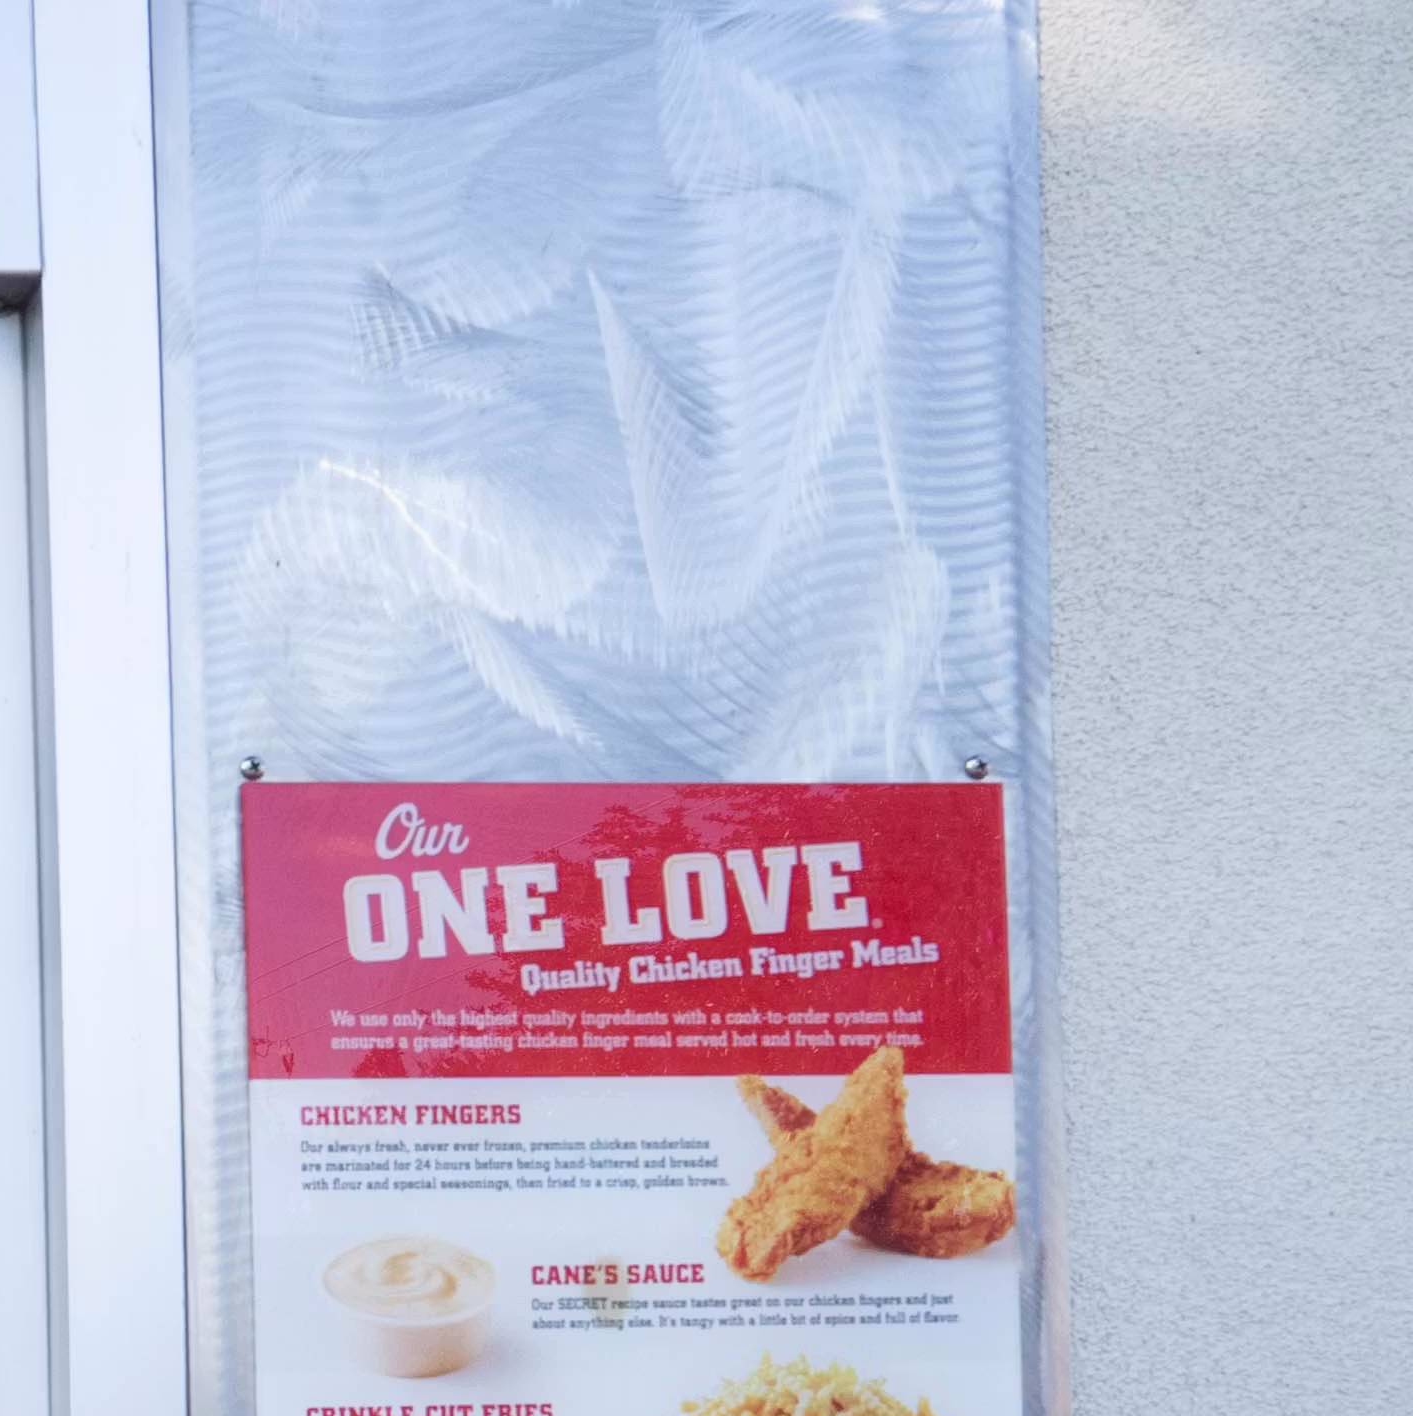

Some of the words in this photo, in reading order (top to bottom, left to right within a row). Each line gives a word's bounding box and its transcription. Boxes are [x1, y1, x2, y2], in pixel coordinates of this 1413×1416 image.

[375, 802, 469, 862] Our
[342, 861, 566, 963] ONE
[594, 842, 870, 947] LOVE
[520, 962, 622, 996] Quality
[628, 951, 742, 986] Chicken
[751, 945, 841, 983] Finger
[851, 938, 939, 969] Meals
[329, 1008, 355, 1026] We
[359, 1013, 387, 1026] use
[392, 1008, 426, 1030] only
[430, 1008, 458, 1026] the
[457, 1008, 519, 1030] highest
[522, 1008, 575, 1029] quality
[580, 1008, 669, 1029] ingredients
[672, 1008, 707, 1025] with
[710, 1012, 721, 1025] a
[724, 1008, 829, 1025] cook-to-order
[833, 1008, 889, 1028] system
[892, 1008, 923, 1025] that
[329, 1037, 395, 1050] ensures
[398, 1037, 408, 1050] a
[411, 1033, 514, 1052] great-tasting
[516, 1032, 578, 1049] chicken
[581, 1032, 629, 1052] finger
[633, 1032, 672, 1048] meal
[676, 1031, 728, 1048] served
[730, 1031, 757, 1047] hot
[760, 1031, 791, 1047] and
[794, 1031, 835, 1047] fresh
[838, 1034, 883, 1050] every
[884, 1030, 924, 1047] time.
[301, 1105, 408, 1126] CHICKEN
[415, 1104, 521, 1125] FINGERS
[531, 1264, 618, 1285] CANE'S
[627, 1263, 705, 1284] SAUCE
